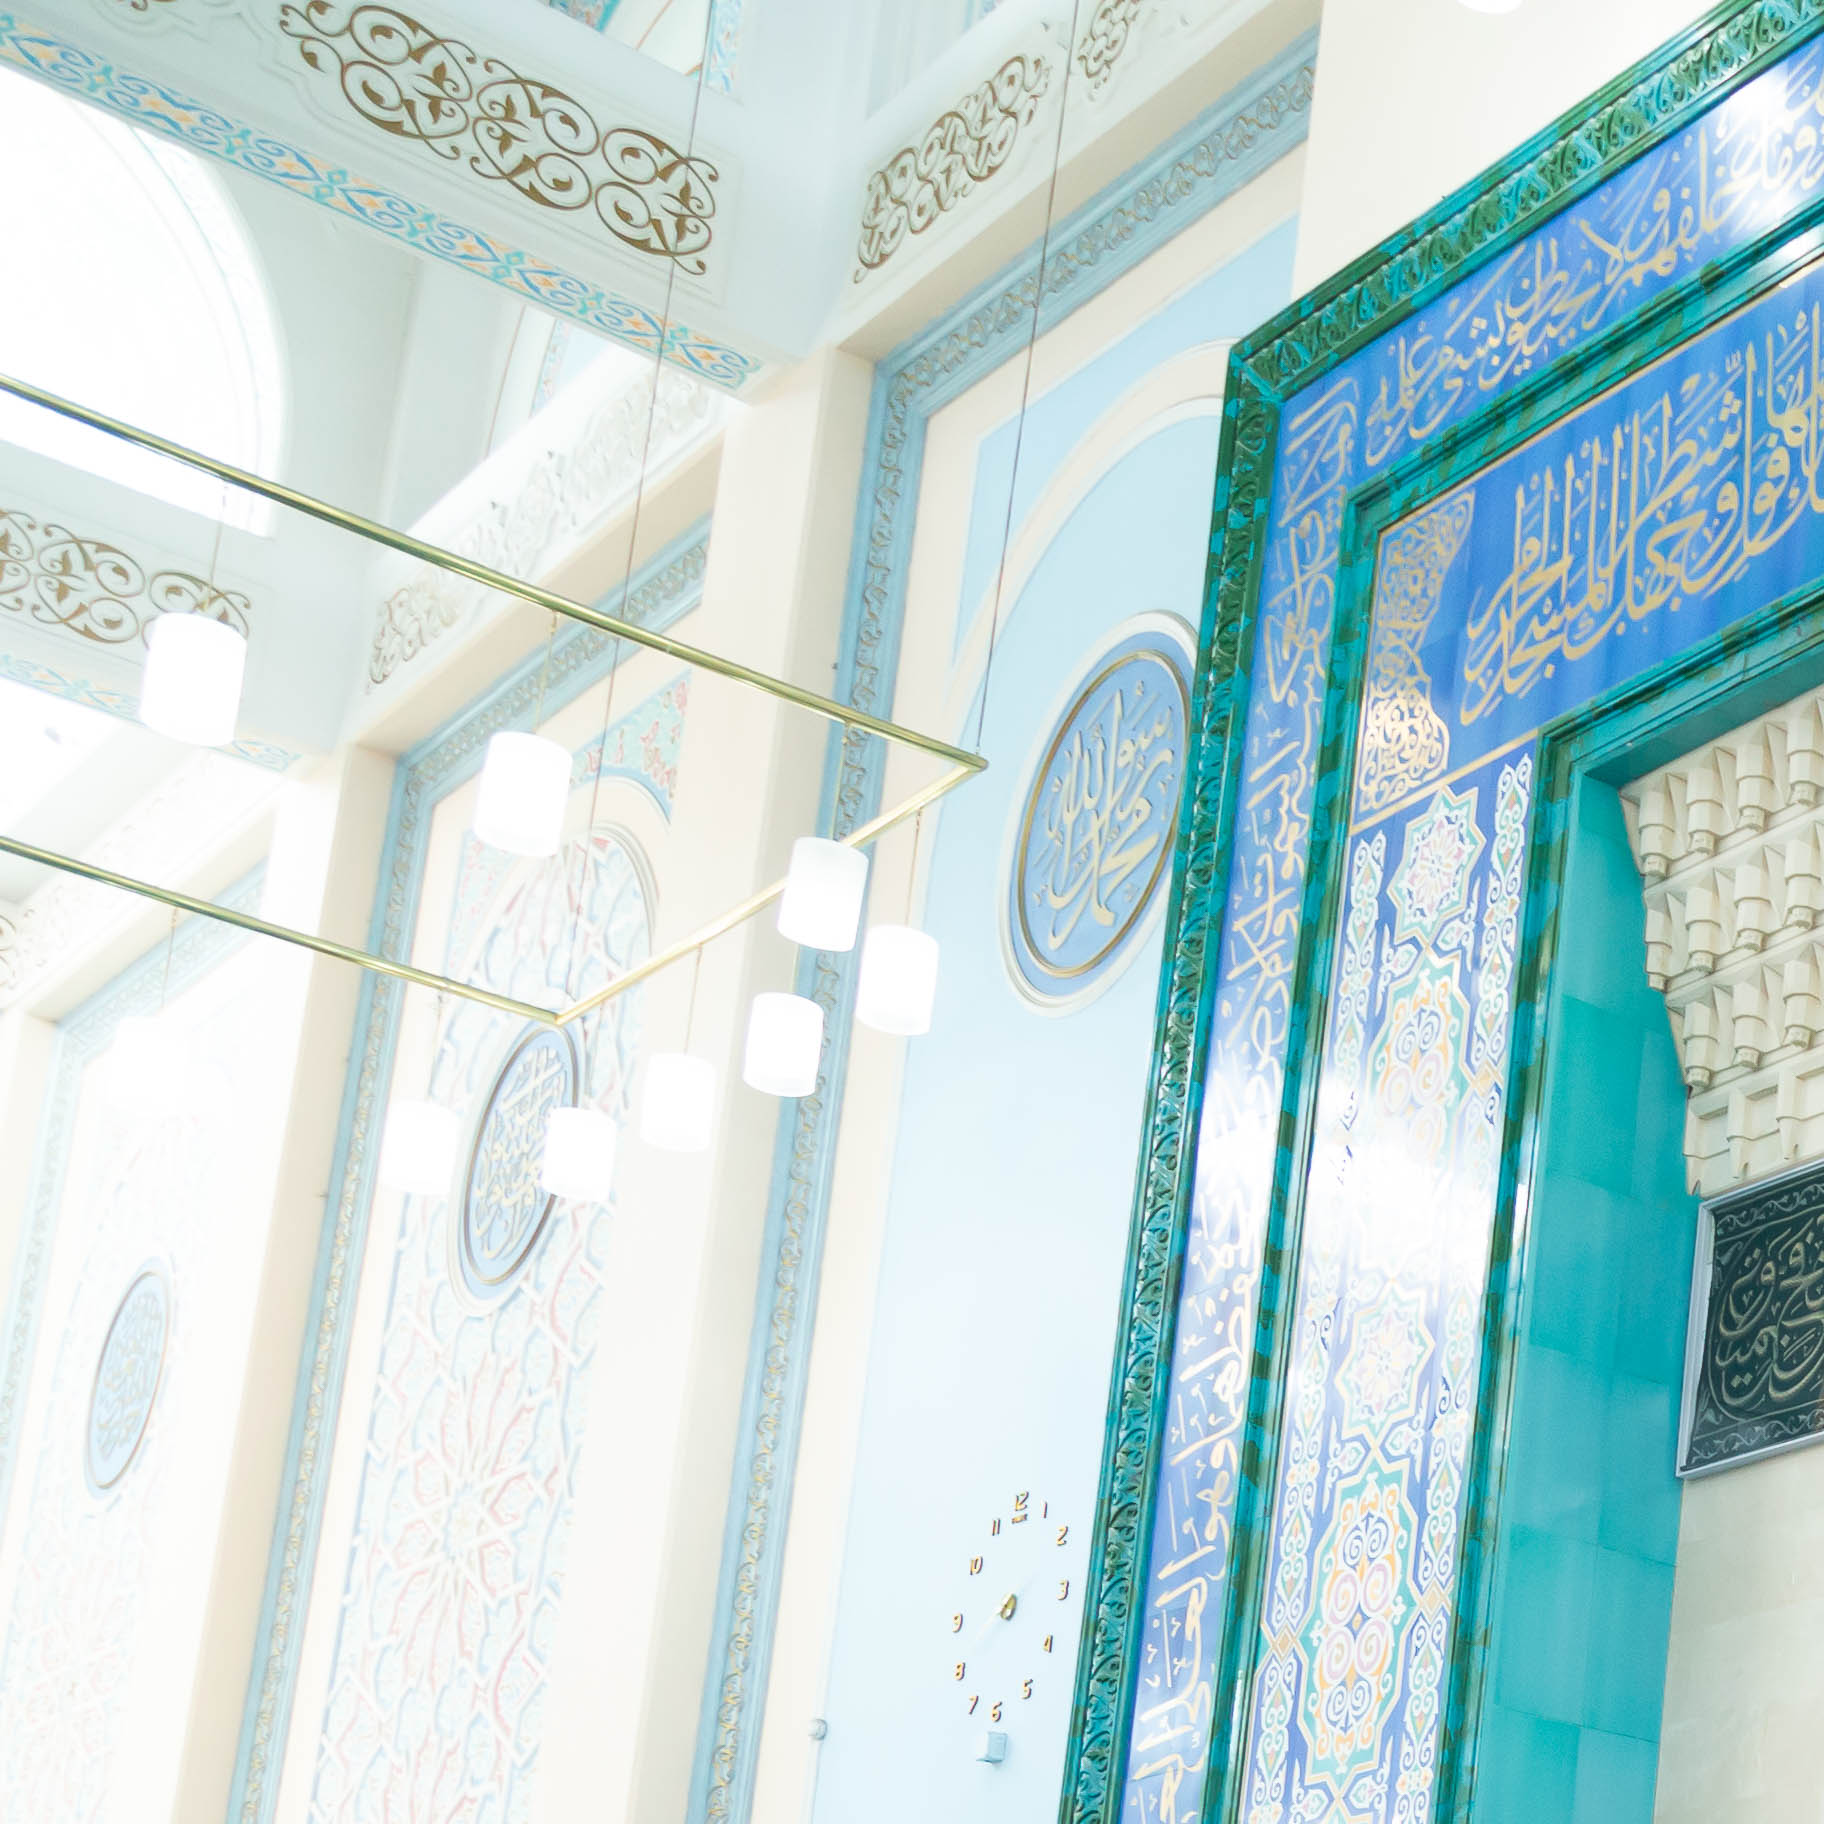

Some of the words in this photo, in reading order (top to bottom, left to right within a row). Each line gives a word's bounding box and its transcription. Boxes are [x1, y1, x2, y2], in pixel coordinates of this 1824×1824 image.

[1015, 1491, 1029, 1511] 12
[1042, 1501, 1048, 1518] 1
[992, 1519, 1001, 1535] 11
[1057, 1526, 1068, 1546] 2
[970, 1556, 982, 1575] 10
[1058, 1580, 1069, 1600] 3
[953, 1613, 962, 1632] 9
[1044, 1635, 1052, 1653] 4
[955, 1662, 965, 1680] 8
[1022, 1679, 1033, 1699] 5
[968, 1696, 978, 1714] 7
[992, 1702, 1001, 1722] 6
